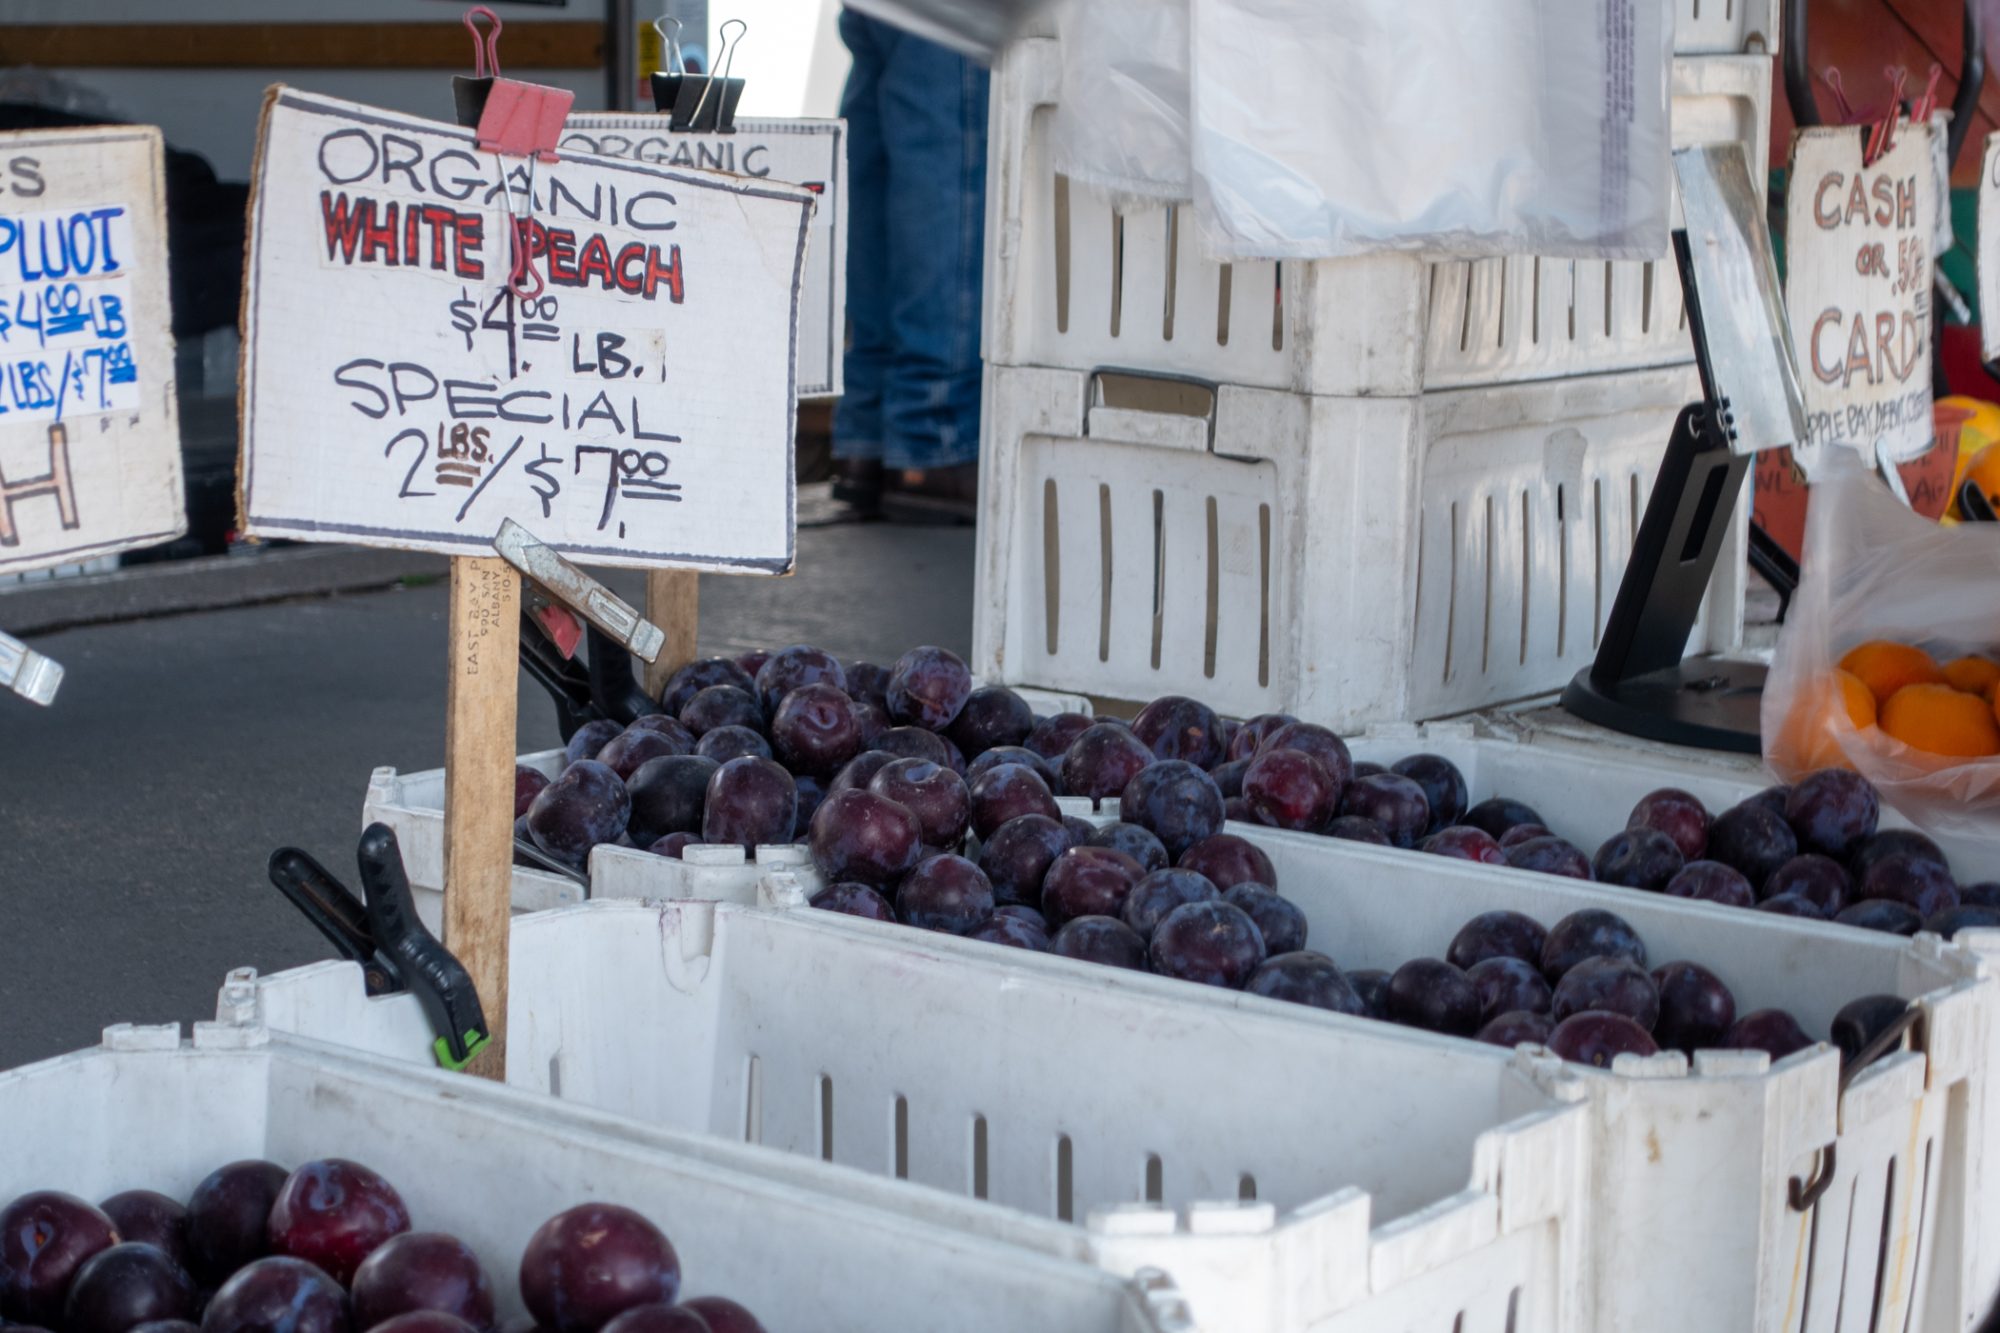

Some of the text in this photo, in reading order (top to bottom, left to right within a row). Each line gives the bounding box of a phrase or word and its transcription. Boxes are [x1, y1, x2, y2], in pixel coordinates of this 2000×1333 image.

[318, 127, 678, 231] ORGANIC
[1812, 170, 1917, 231] CASH
[0, 207, 125, 281] PLUOT
[320, 189, 684, 304] WHITE PEACH
[1856, 242, 1890, 279] OR
[1809, 306, 1919, 390] CARD
[334, 358, 682, 443] SPECIAL
[467, 630, 480, 676] EAST
